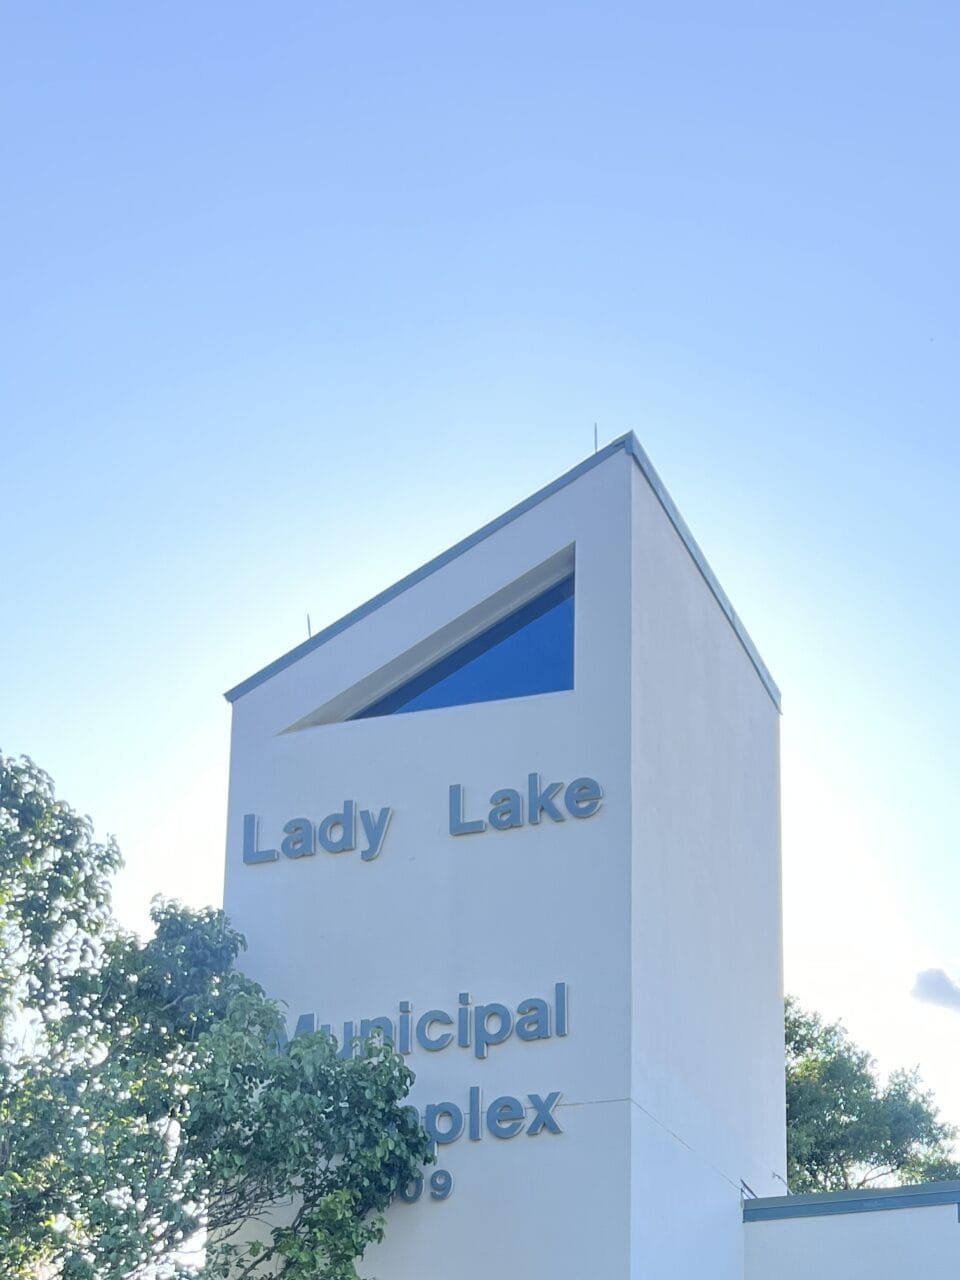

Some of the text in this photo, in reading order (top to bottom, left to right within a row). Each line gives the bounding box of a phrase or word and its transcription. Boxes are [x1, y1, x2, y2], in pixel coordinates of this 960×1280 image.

[242, 772, 604, 866] Lady Lake
[402, 1086, 562, 1157] plex
[394, 1169, 454, 1204] 09
